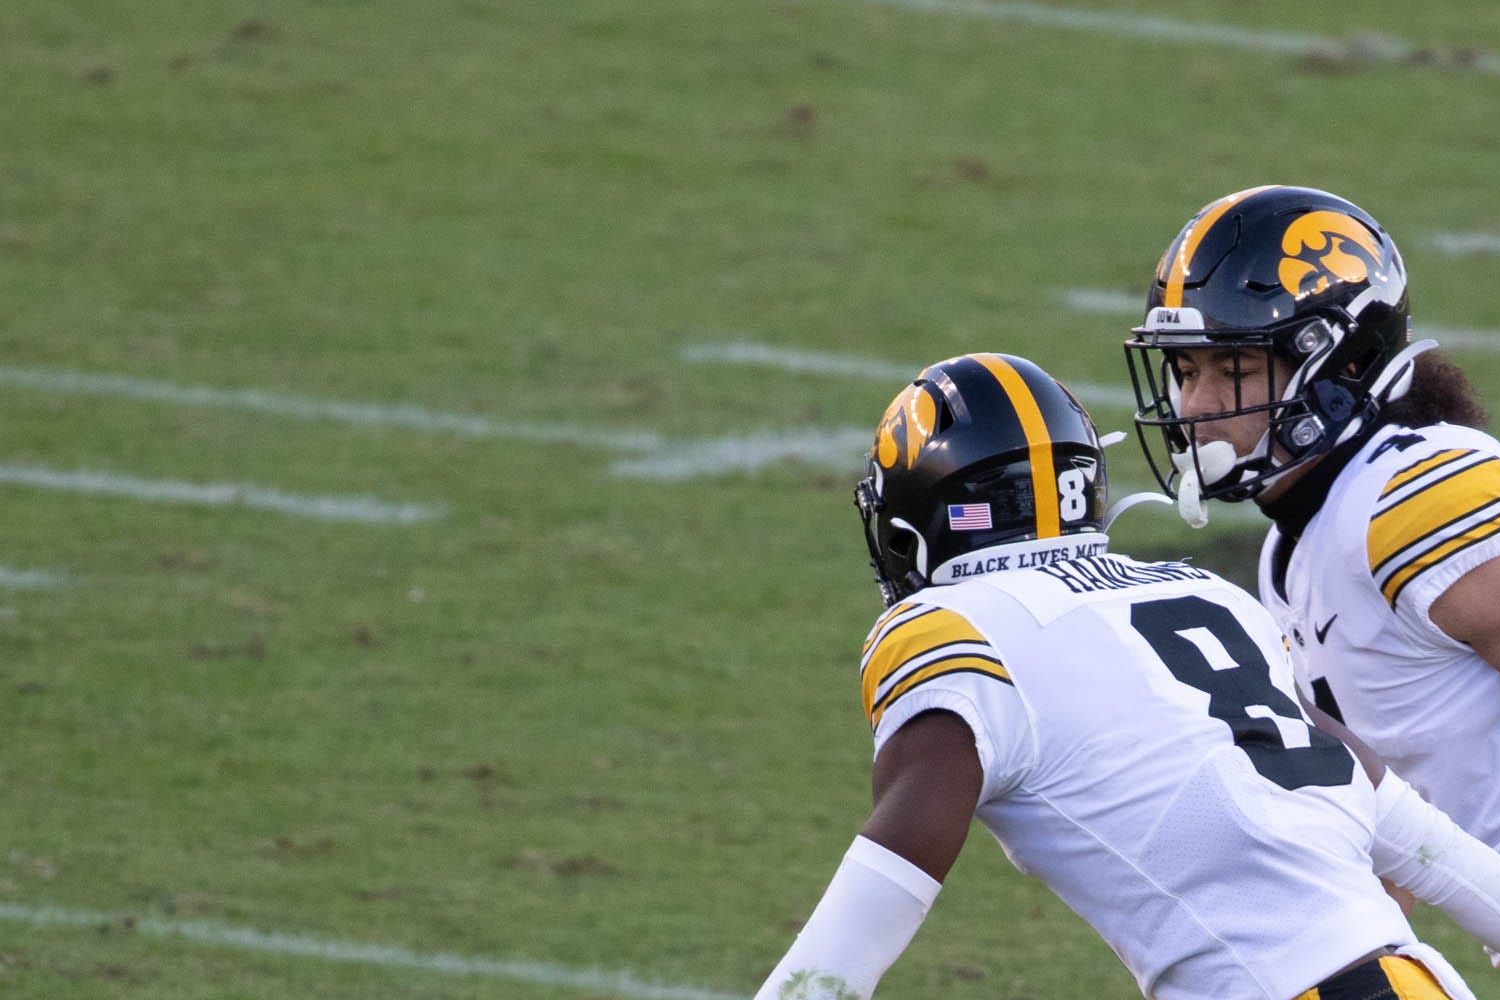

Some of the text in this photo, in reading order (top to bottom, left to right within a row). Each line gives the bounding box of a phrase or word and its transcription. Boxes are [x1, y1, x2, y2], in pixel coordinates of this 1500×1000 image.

[1156, 310, 1181, 323] IOWA
[1058, 468, 1087, 522] 8
[951, 556, 1010, 579] BLACK
[1017, 547, 1069, 570] LIVES
[1131, 596, 1356, 791] 8
